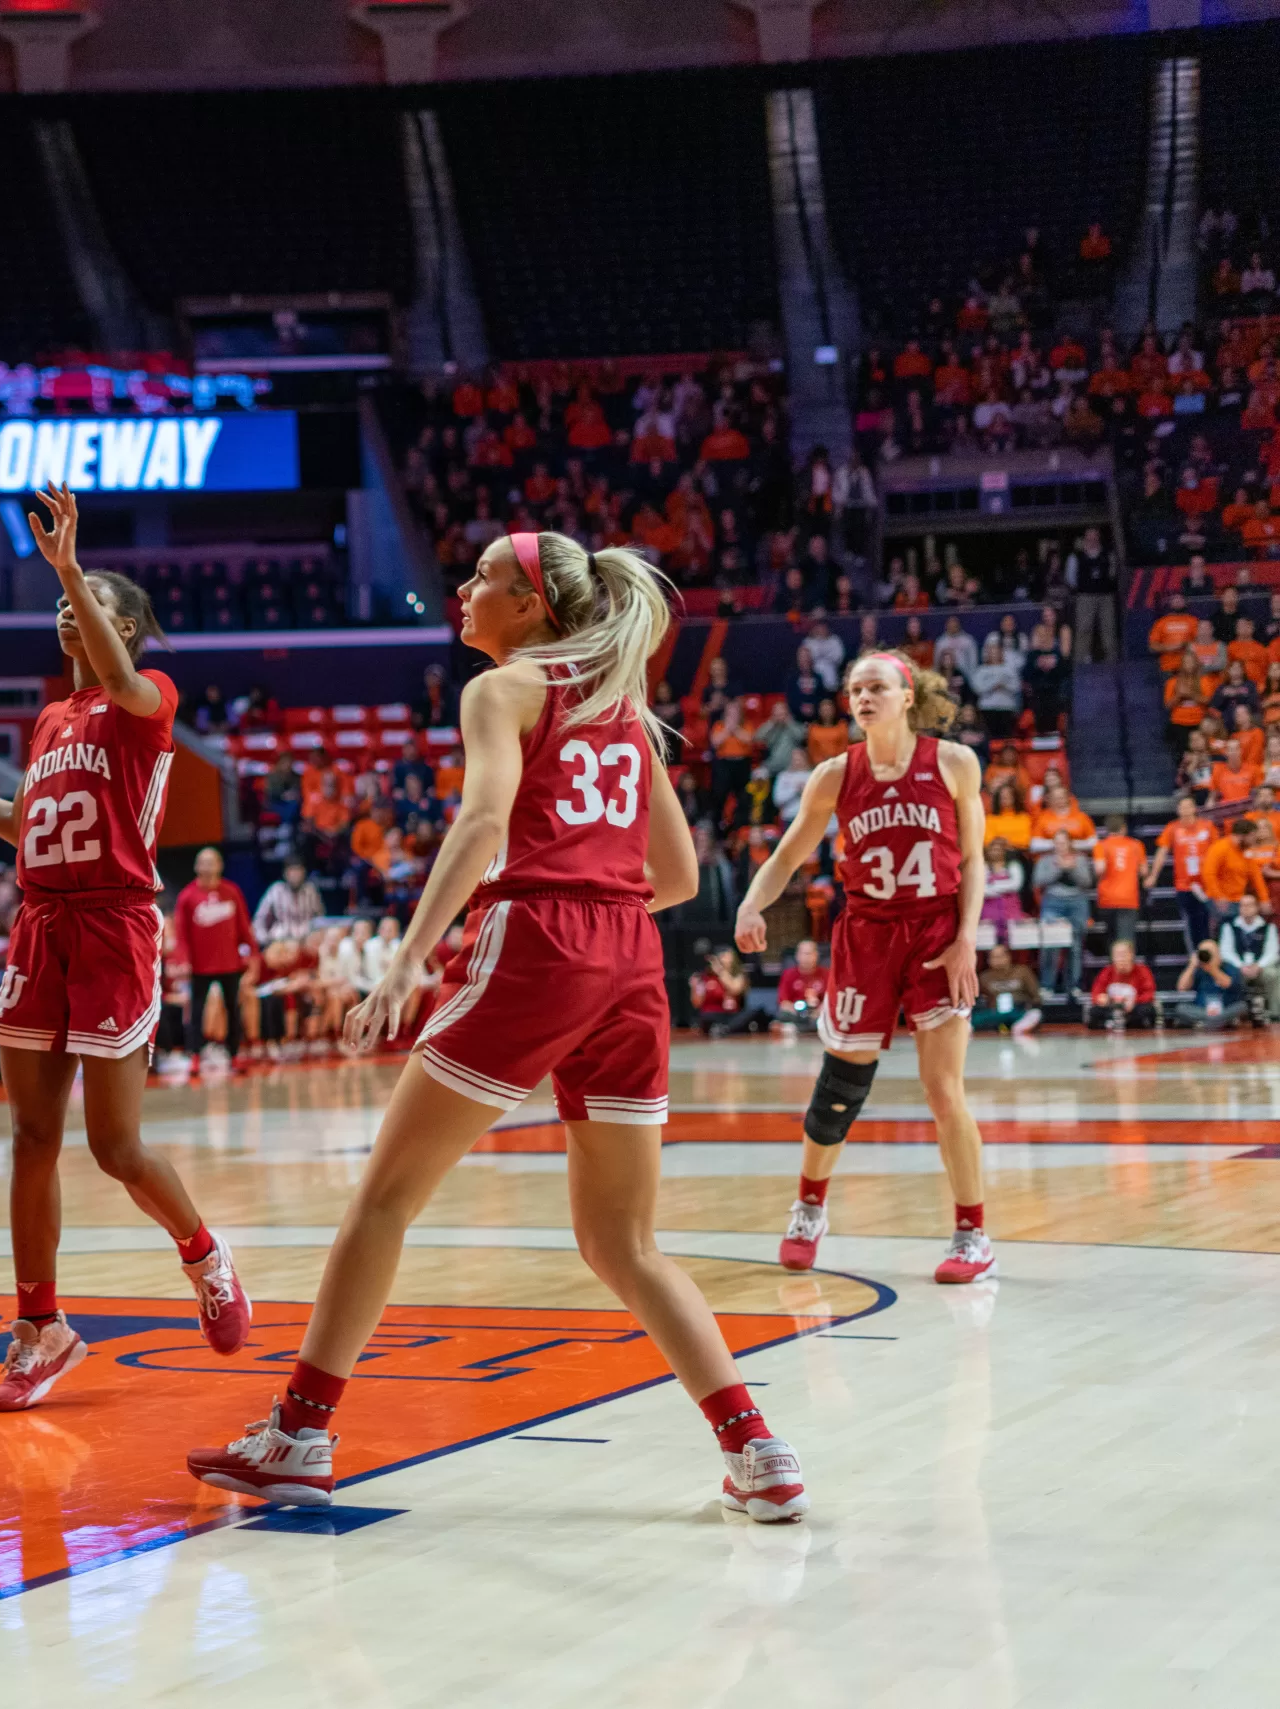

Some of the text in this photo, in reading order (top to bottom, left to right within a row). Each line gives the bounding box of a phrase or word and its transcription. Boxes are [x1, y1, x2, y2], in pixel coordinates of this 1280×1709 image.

[23, 743, 112, 796] INDIANA
[556, 739, 642, 829] 33
[24, 790, 102, 868] 22
[848, 802, 941, 844] INDIANA
[860, 840, 938, 900] 34
[763, 1457, 793, 1472] INDIANA
